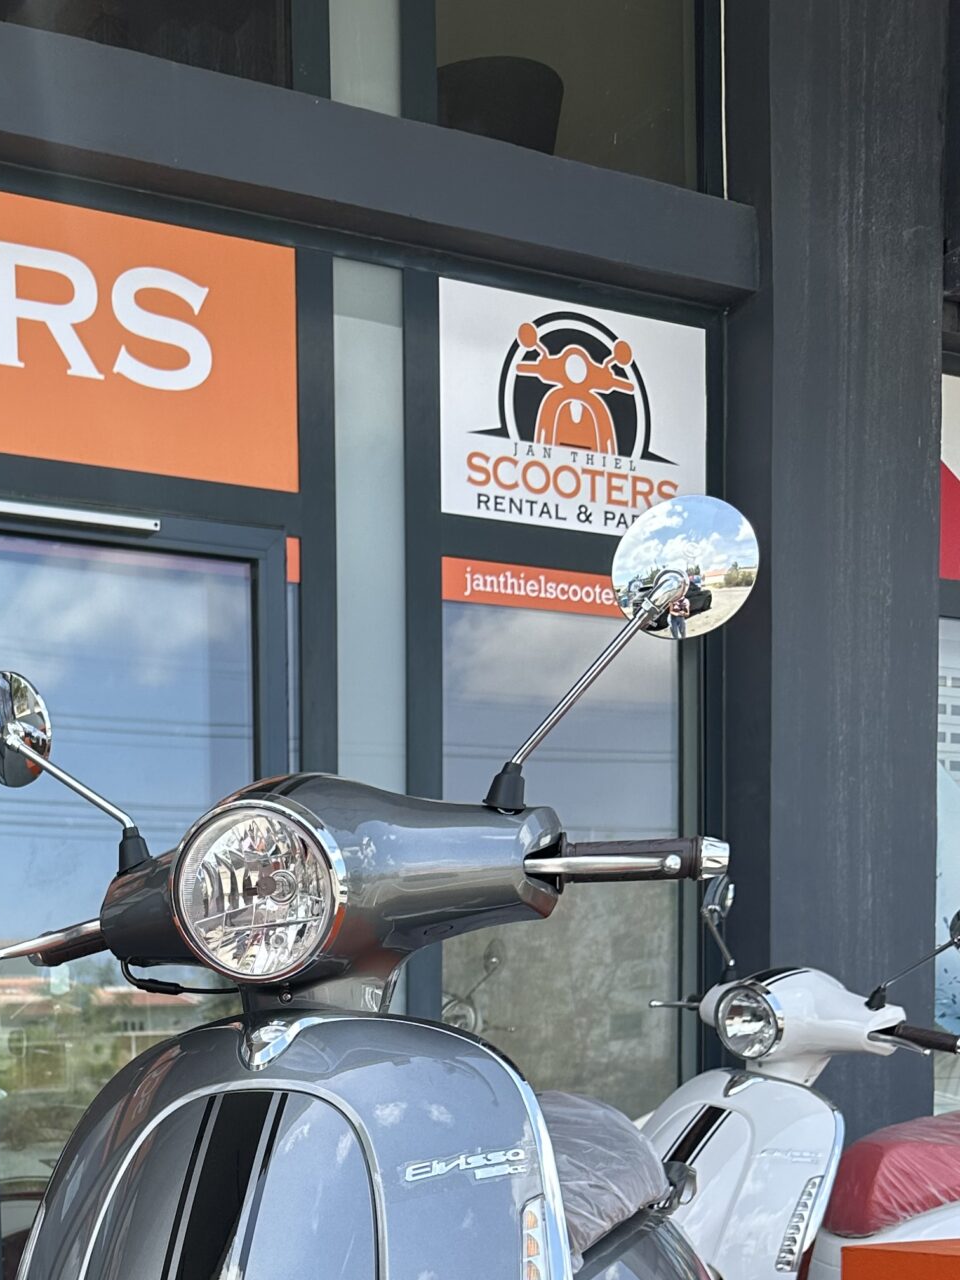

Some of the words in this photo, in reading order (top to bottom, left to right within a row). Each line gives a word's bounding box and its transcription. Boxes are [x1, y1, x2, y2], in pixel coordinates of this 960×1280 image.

[512, 442, 553, 460] JAN
[570, 451, 637, 473] THIEL
[466, 451, 679, 508] SCOOTERS
[476, 493, 568, 521] RENTAL
[576, 504, 593, 524] &
[463, 566, 619, 607] janthielscoote
